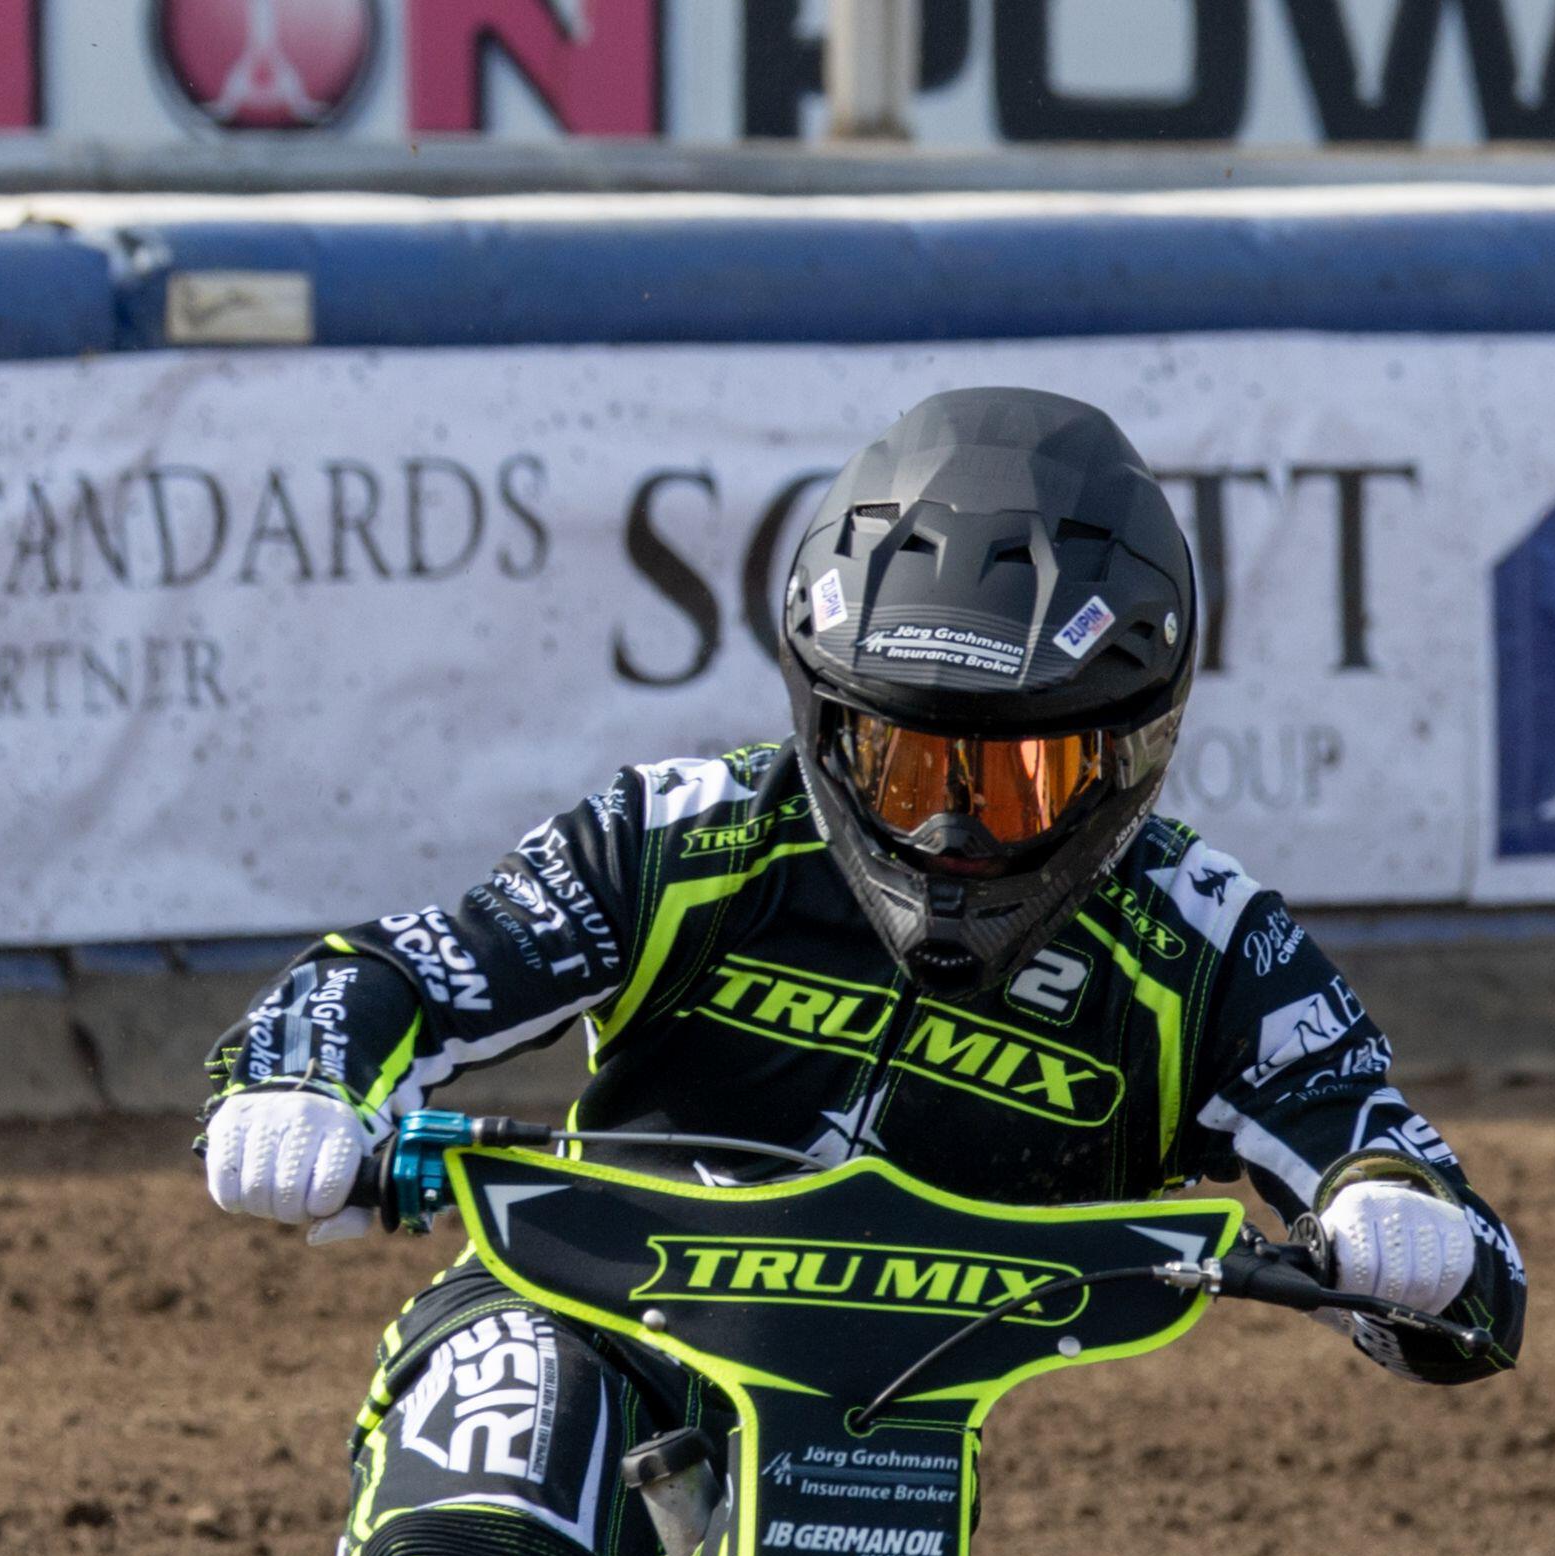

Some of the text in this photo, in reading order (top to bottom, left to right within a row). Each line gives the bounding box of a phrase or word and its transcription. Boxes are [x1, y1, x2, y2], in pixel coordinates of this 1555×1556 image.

[611, 464, 1422, 689] STT
[892, 625, 1025, 656] Jörg Grohmann
[1060, 601, 1105, 648] ZUPIN
[886, 645, 1019, 676] Insurance Broker
[1008, 948, 1091, 1014] 2
[708, 965, 1100, 1111] TRU MIX
[682, 1247, 1056, 1313] TRU MIX
[802, 1445, 959, 1471] Jörg Grohmann
[800, 1478, 956, 1503] Insurance Broker
[762, 1520, 946, 1556] JB GERMAN OIL
